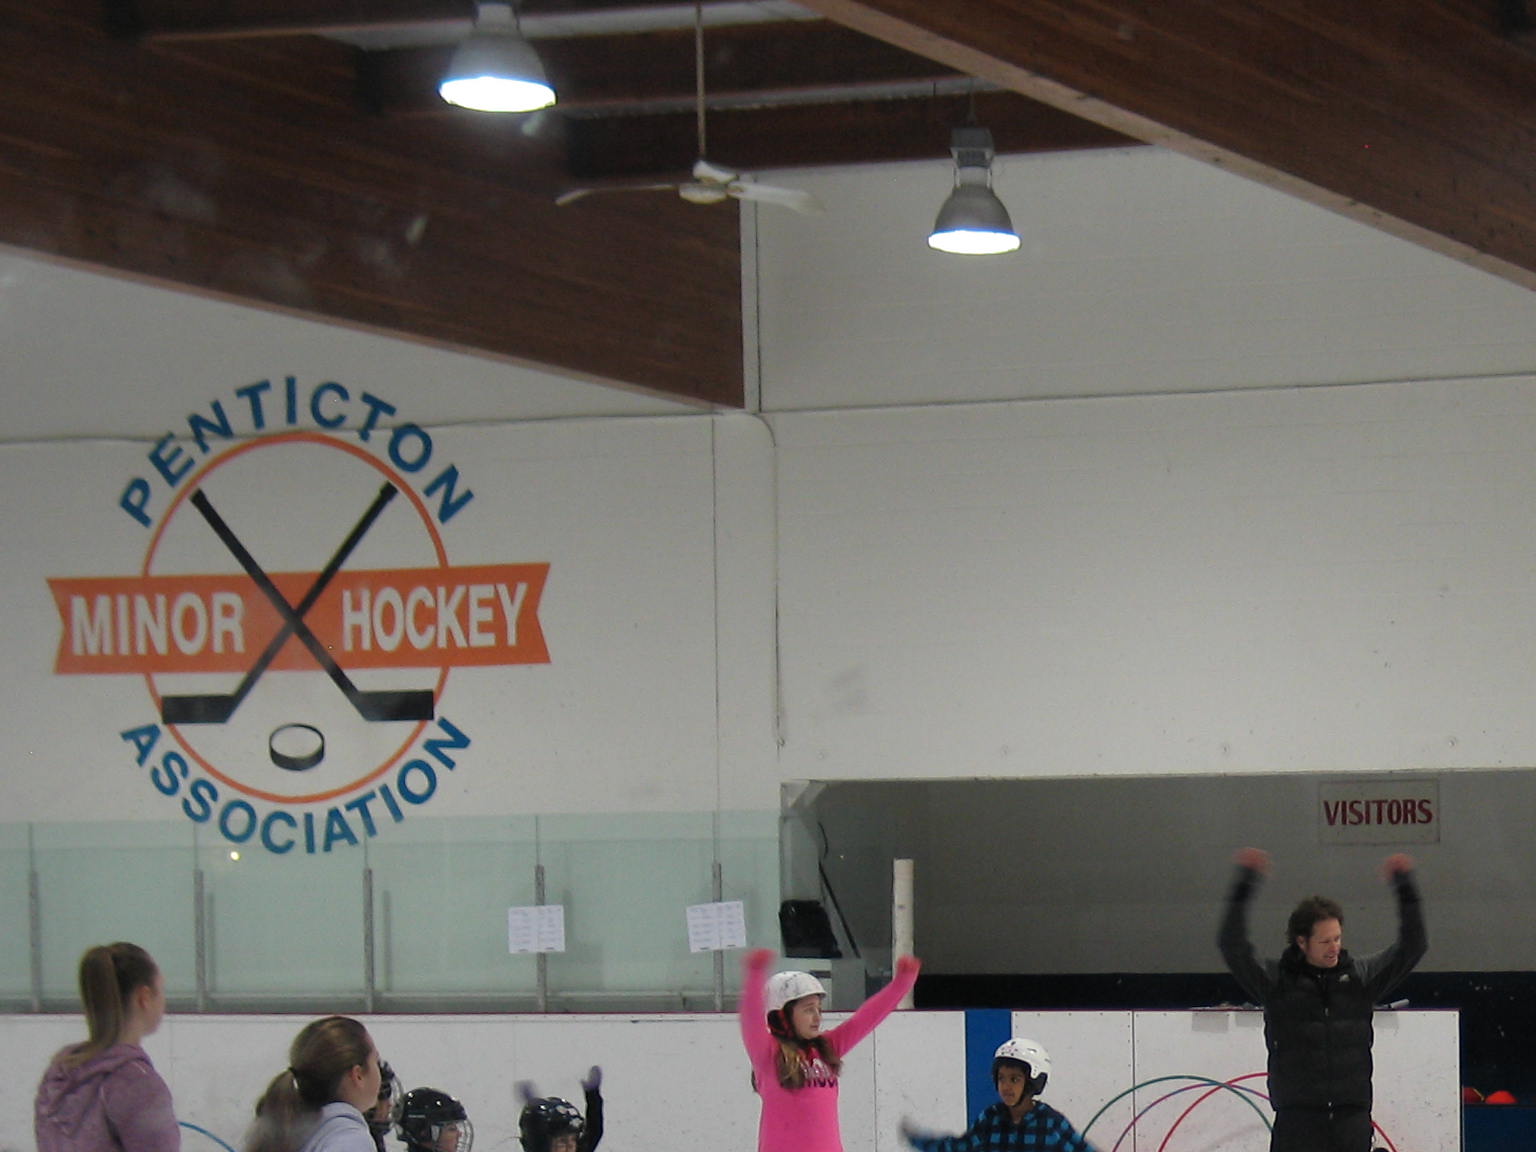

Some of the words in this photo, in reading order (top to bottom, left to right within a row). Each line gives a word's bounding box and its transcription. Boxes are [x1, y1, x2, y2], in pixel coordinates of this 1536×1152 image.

[119, 376, 474, 528] PENTICTON
[70, 591, 246, 656] MINOR
[341, 582, 528, 652] HOCKEY
[119, 717, 472, 855] ASSOCIATION
[1323, 798, 1433, 826] VISITORS
